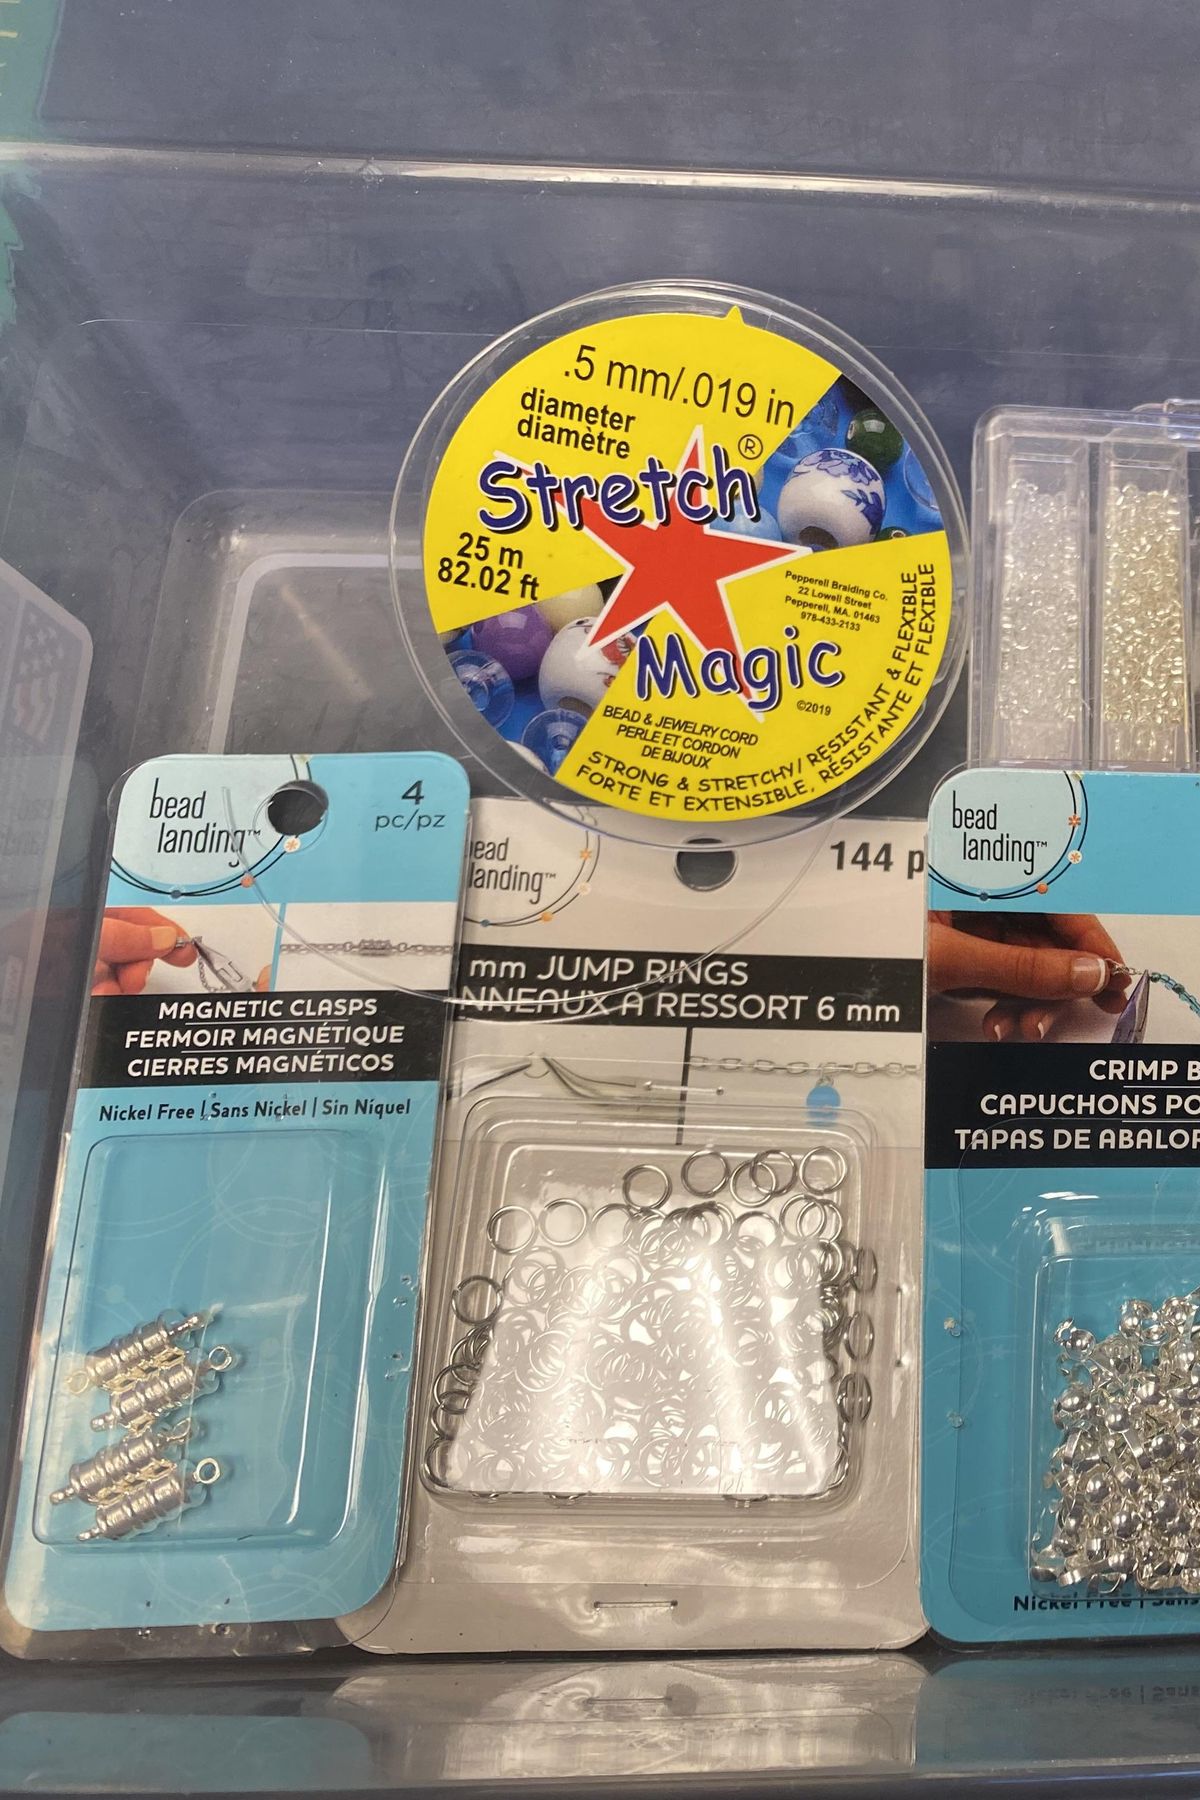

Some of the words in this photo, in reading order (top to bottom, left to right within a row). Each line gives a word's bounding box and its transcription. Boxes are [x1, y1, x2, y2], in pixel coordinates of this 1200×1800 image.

[564, 344, 596, 381] .5
[606, 359, 757, 418] mm/.019
[766, 389, 795, 428] in
[521, 387, 636, 433] diameter
[517, 415, 630, 459] diamètre
[478, 444, 761, 531] Stretch
[457, 532, 490, 561] 25
[499, 546, 524, 569] m
[437, 557, 511, 595] 82.02
[520, 574, 539, 601] ft
[785, 570, 829, 587] Pepperell
[831, 581, 870, 598] Braiding
[873, 590, 888, 601] Co.
[785, 595, 831, 614] Pepperell,
[834, 606, 851, 617] MA.
[853, 611, 880, 624] 01463
[798, 586, 809, 595] 22
[812, 589, 842, 603] Lowell
[844, 597, 872, 609] Street
[800, 611, 860, 632] 978-433-2133
[892, 572, 917, 663] FLEXIBLE
[634, 627, 847, 714] Magic
[886, 668, 902, 681] &
[576, 764, 643, 801] FORTE
[649, 791, 675, 808] ET
[684, 779, 815, 812] EXTENSIBLE,
[818, 690, 912, 783] RÉSISTANTE
[905, 661, 924, 687] ET
[915, 562, 936, 657] FLEXIBLE
[603, 705, 641, 723] BEAD
[643, 713, 653, 725] &
[655, 716, 720, 738] JEWELRY
[720, 728, 758, 746] CORD
[616, 724, 662, 743] PERLE
[662, 733, 682, 747] ET
[682, 737, 741, 759] CORDON
[641, 745, 662, 759] DE
[662, 750, 712, 769] BIJOUX
[588, 751, 669, 789] STRONG
[677, 777, 689, 791] &
[149, 777, 207, 819] bead
[402, 780, 425, 806] 4
[374, 809, 446, 832] pc/pz
[952, 790, 997, 830] bead
[830, 840, 893, 872] 144
[907, 850, 925, 880] p
[470, 958, 527, 979] mm
[537, 955, 635, 982] JUMP
[646, 957, 749, 986] RINGS
[158, 1000, 284, 1020] MAGNETIC
[289, 998, 377, 1018] CLASPS
[460, 985, 609, 1015] NNEAUX
[655, 992, 808, 1020] RESSORT
[817, 995, 835, 1020] 6
[846, 1002, 900, 1023] mm
[124, 1027, 236, 1049] FERMOIR
[242, 1022, 405, 1046] MAGNÉTIQUE
[127, 1056, 229, 1078] CIERRES
[235, 1050, 394, 1075] MAGNÉTICOS
[1089, 1060, 1180, 1082] CRIMP
[99, 1104, 152, 1122] Nickel
[157, 1104, 195, 1120] Free
[210, 1101, 249, 1119] Sans
[254, 1099, 306, 1118] Nickel
[322, 1099, 349, 1116] Sin
[354, 1097, 411, 1120] Níquel
[980, 1093, 1158, 1116] CAPUCHONS
[955, 1129, 1045, 1150] TAPAS
[1052, 1129, 1092, 1150] DE
